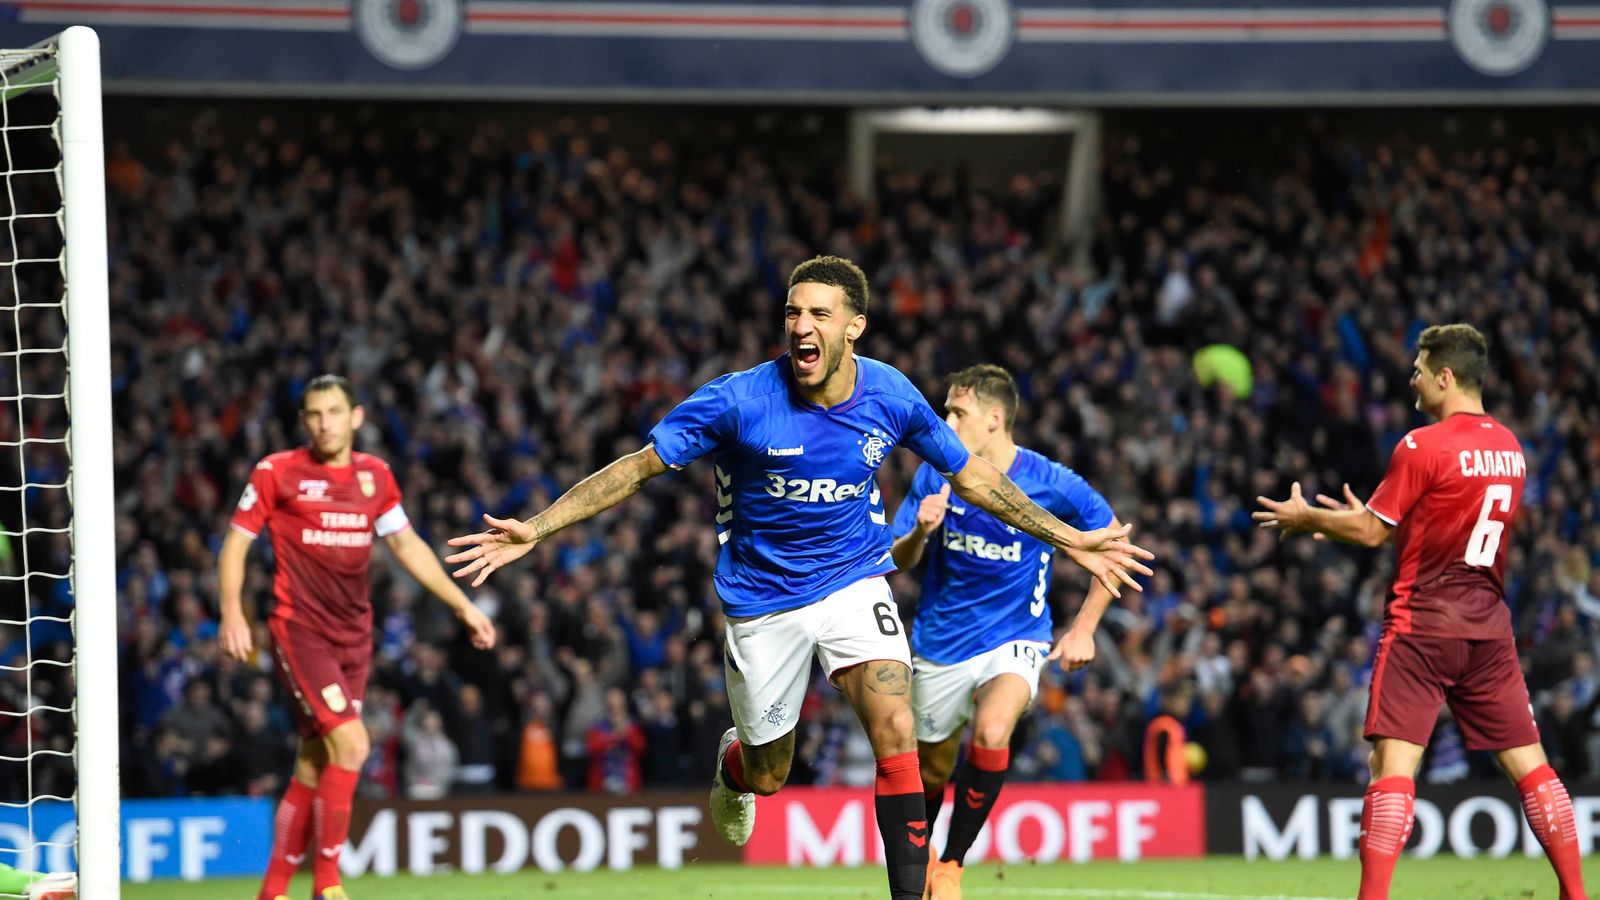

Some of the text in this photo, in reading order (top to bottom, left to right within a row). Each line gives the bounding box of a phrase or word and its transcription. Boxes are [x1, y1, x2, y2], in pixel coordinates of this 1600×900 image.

[768, 445, 804, 456] hummel
[765, 473, 872, 503] 32Red
[320, 511, 368, 529] TERRA
[1465, 484, 1512, 567] 6
[943, 531, 1022, 563] 2Red
[872, 602, 899, 636] 6
[1013, 643, 1036, 668] 19
[338, 807, 702, 878] MEDOFF
[785, 801, 1161, 867] MDOFF
